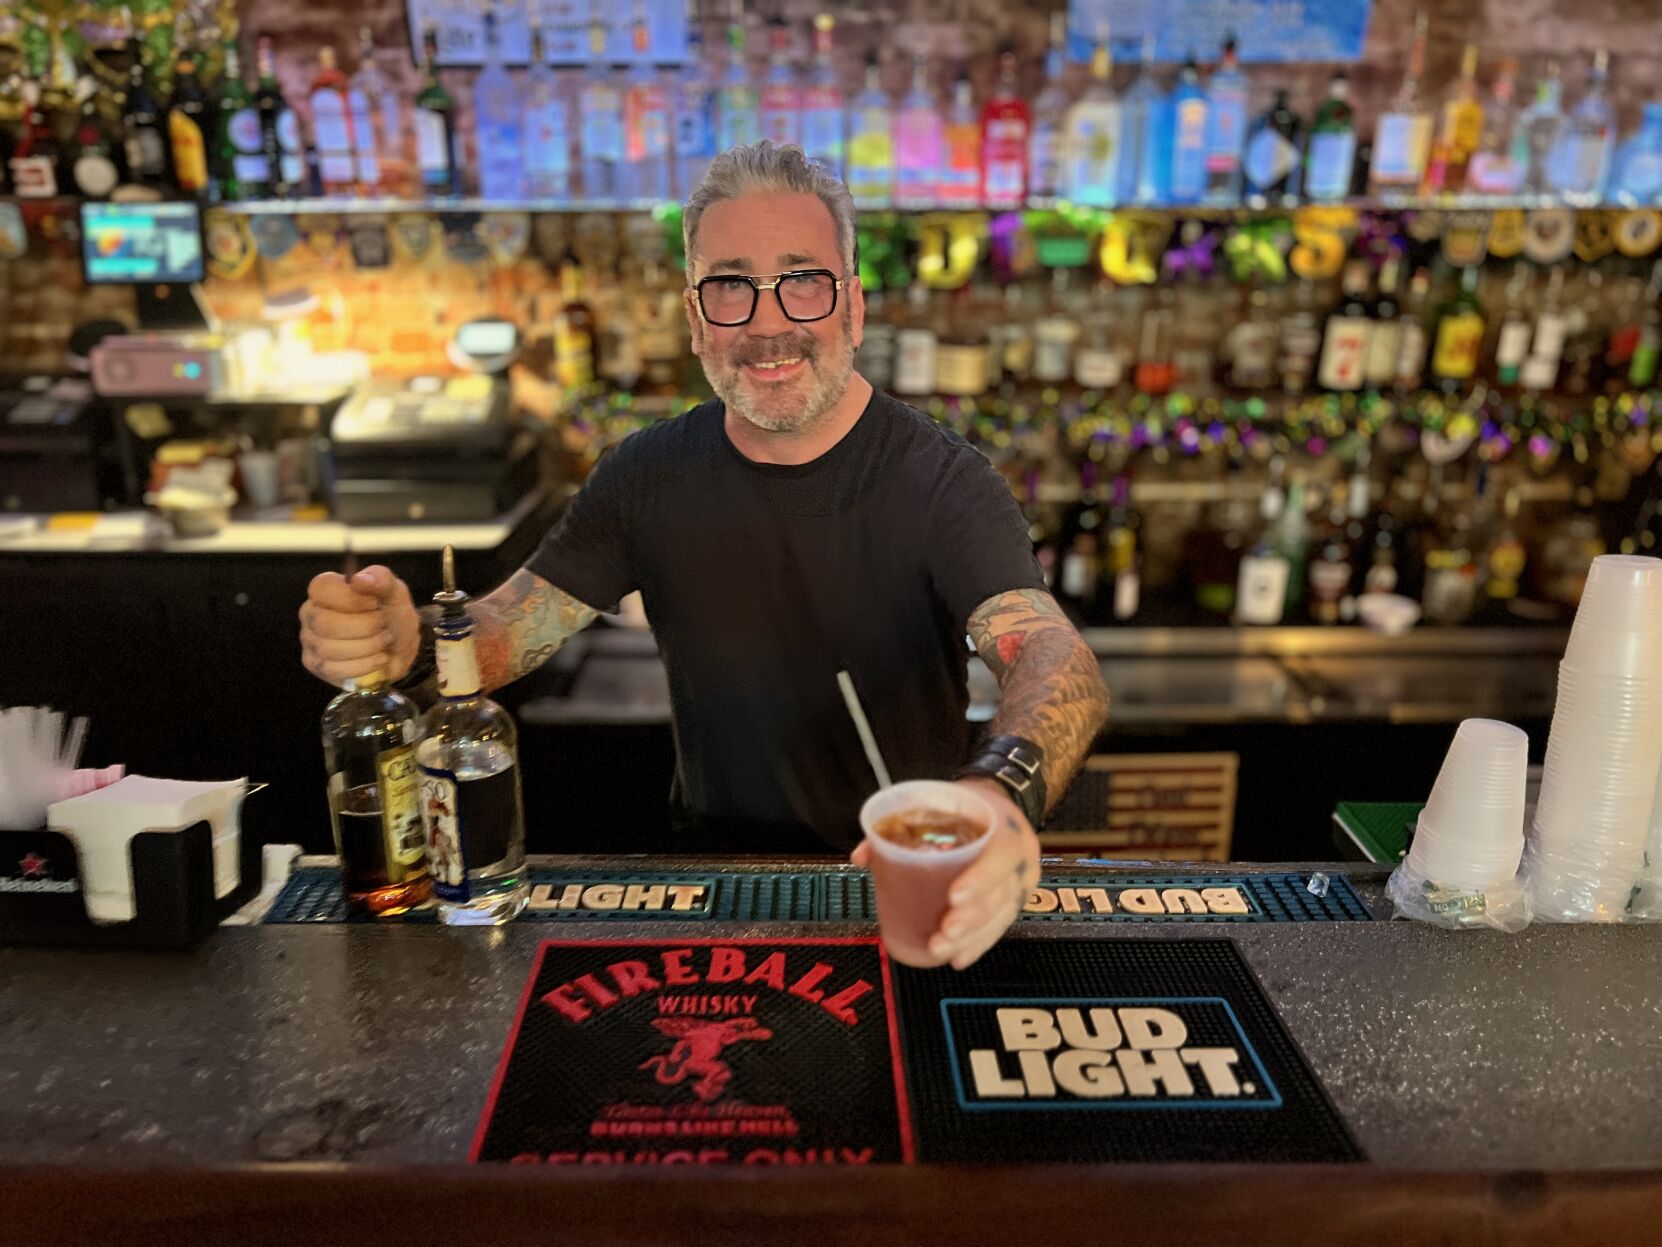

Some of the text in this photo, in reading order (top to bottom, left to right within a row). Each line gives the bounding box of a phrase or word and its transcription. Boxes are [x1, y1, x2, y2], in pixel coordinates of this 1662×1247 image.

[1021, 887, 1249, 915] BUD LIG
[542, 947, 874, 1025] FIREBALL
[657, 994, 758, 1014] WHISKY
[996, 1007, 1188, 1051] BUD
[969, 1047, 1256, 1097] LIGHT.
